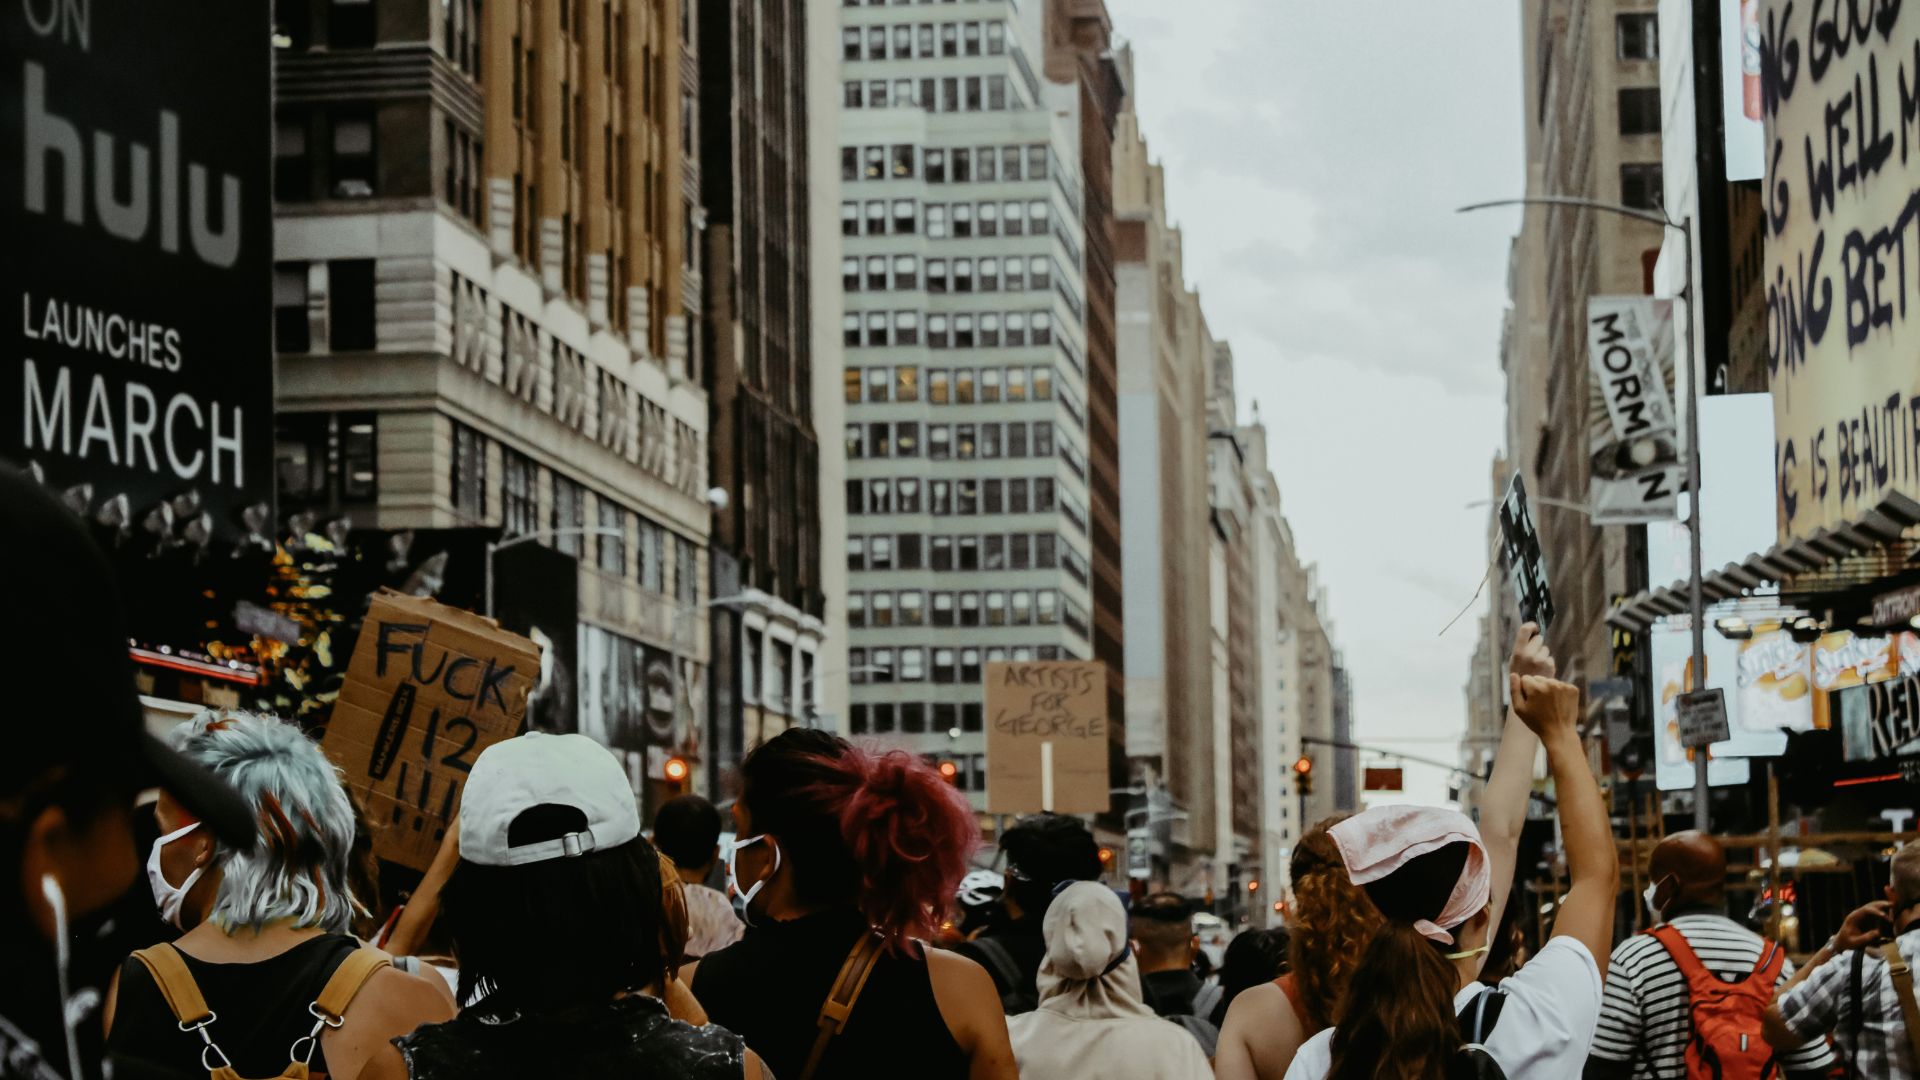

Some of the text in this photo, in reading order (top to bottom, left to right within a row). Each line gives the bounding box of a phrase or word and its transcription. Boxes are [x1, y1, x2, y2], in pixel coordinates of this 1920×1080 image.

[24, 59, 241, 268] hulu
[1805, 52, 1893, 222] WELL
[23, 291, 182, 373] LAUNCHES
[23, 358, 244, 489] MARCH
[1811, 427, 1828, 500] IS
[375, 620, 516, 715] FUCK
[1003, 666, 1096, 696] ARTISTS
[1030, 691, 1073, 717] FOR
[422, 707, 479, 774] 12
[993, 709, 1105, 740] GEORGE
